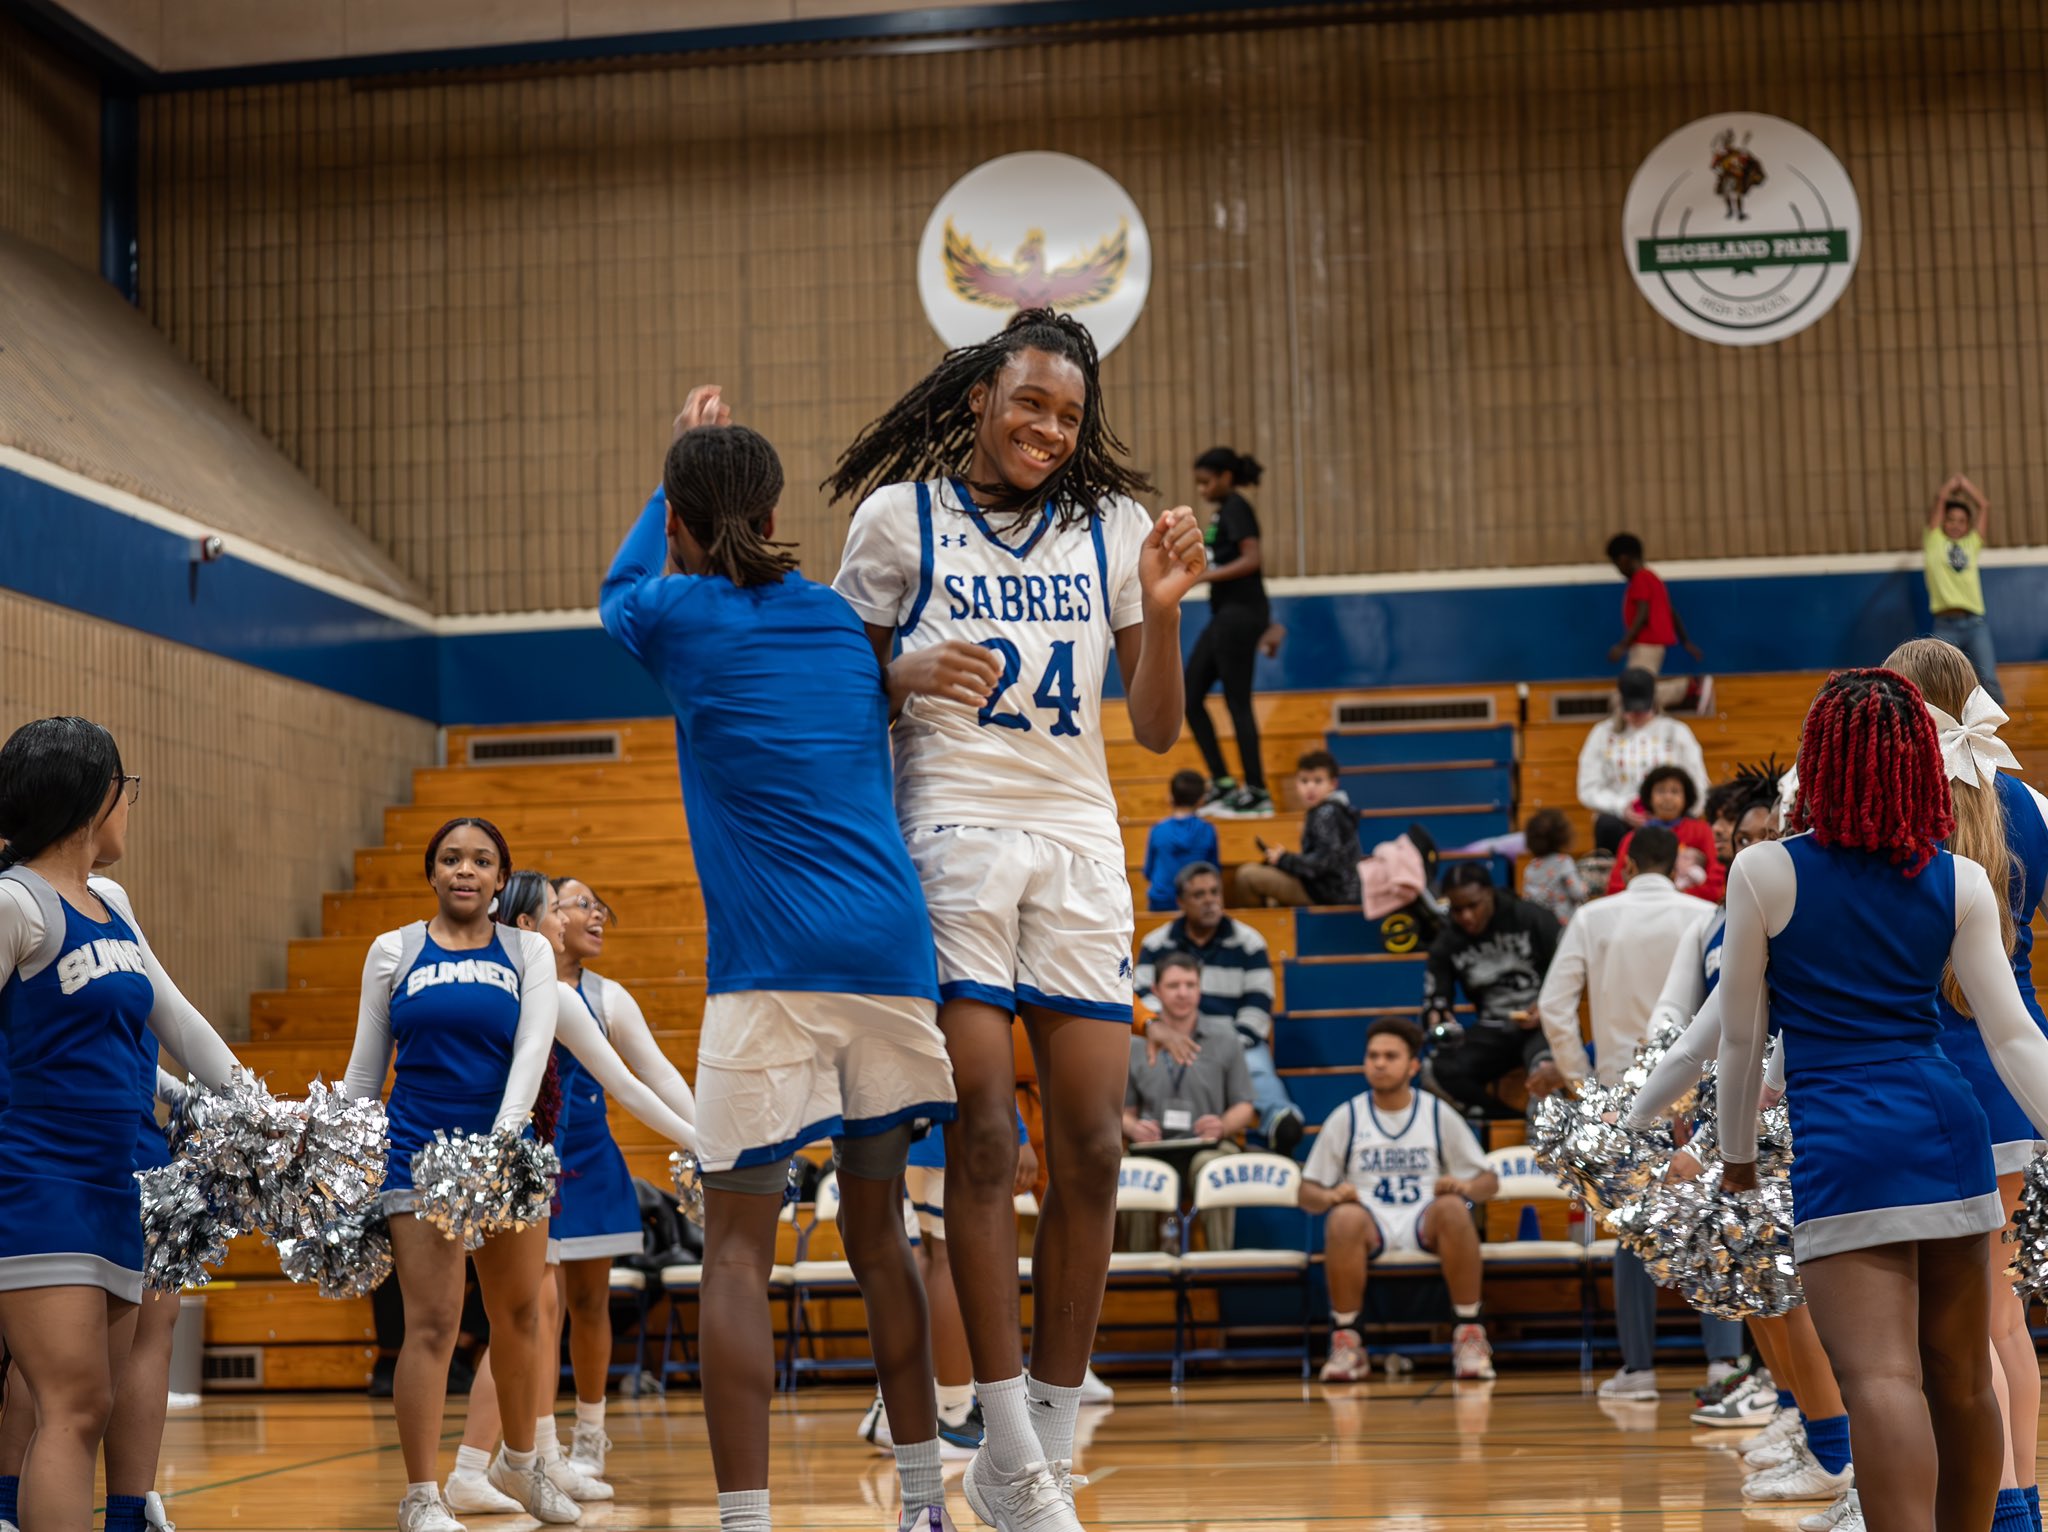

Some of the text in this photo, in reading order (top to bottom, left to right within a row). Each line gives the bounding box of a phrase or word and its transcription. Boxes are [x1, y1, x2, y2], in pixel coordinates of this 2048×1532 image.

[1655, 236, 1831, 263] HIGHLAND PARK
[944, 573, 1092, 622] SABRES
[972, 637, 1082, 737] 24
[57, 938, 147, 995] SUMNE
[407, 959, 520, 1001] SUMNER
[1359, 1148, 1429, 1171] SABRES
[1118, 1169, 1168, 1192] BRES
[1208, 1164, 1291, 1188] SABRES
[1373, 1175, 1421, 1204] 45
